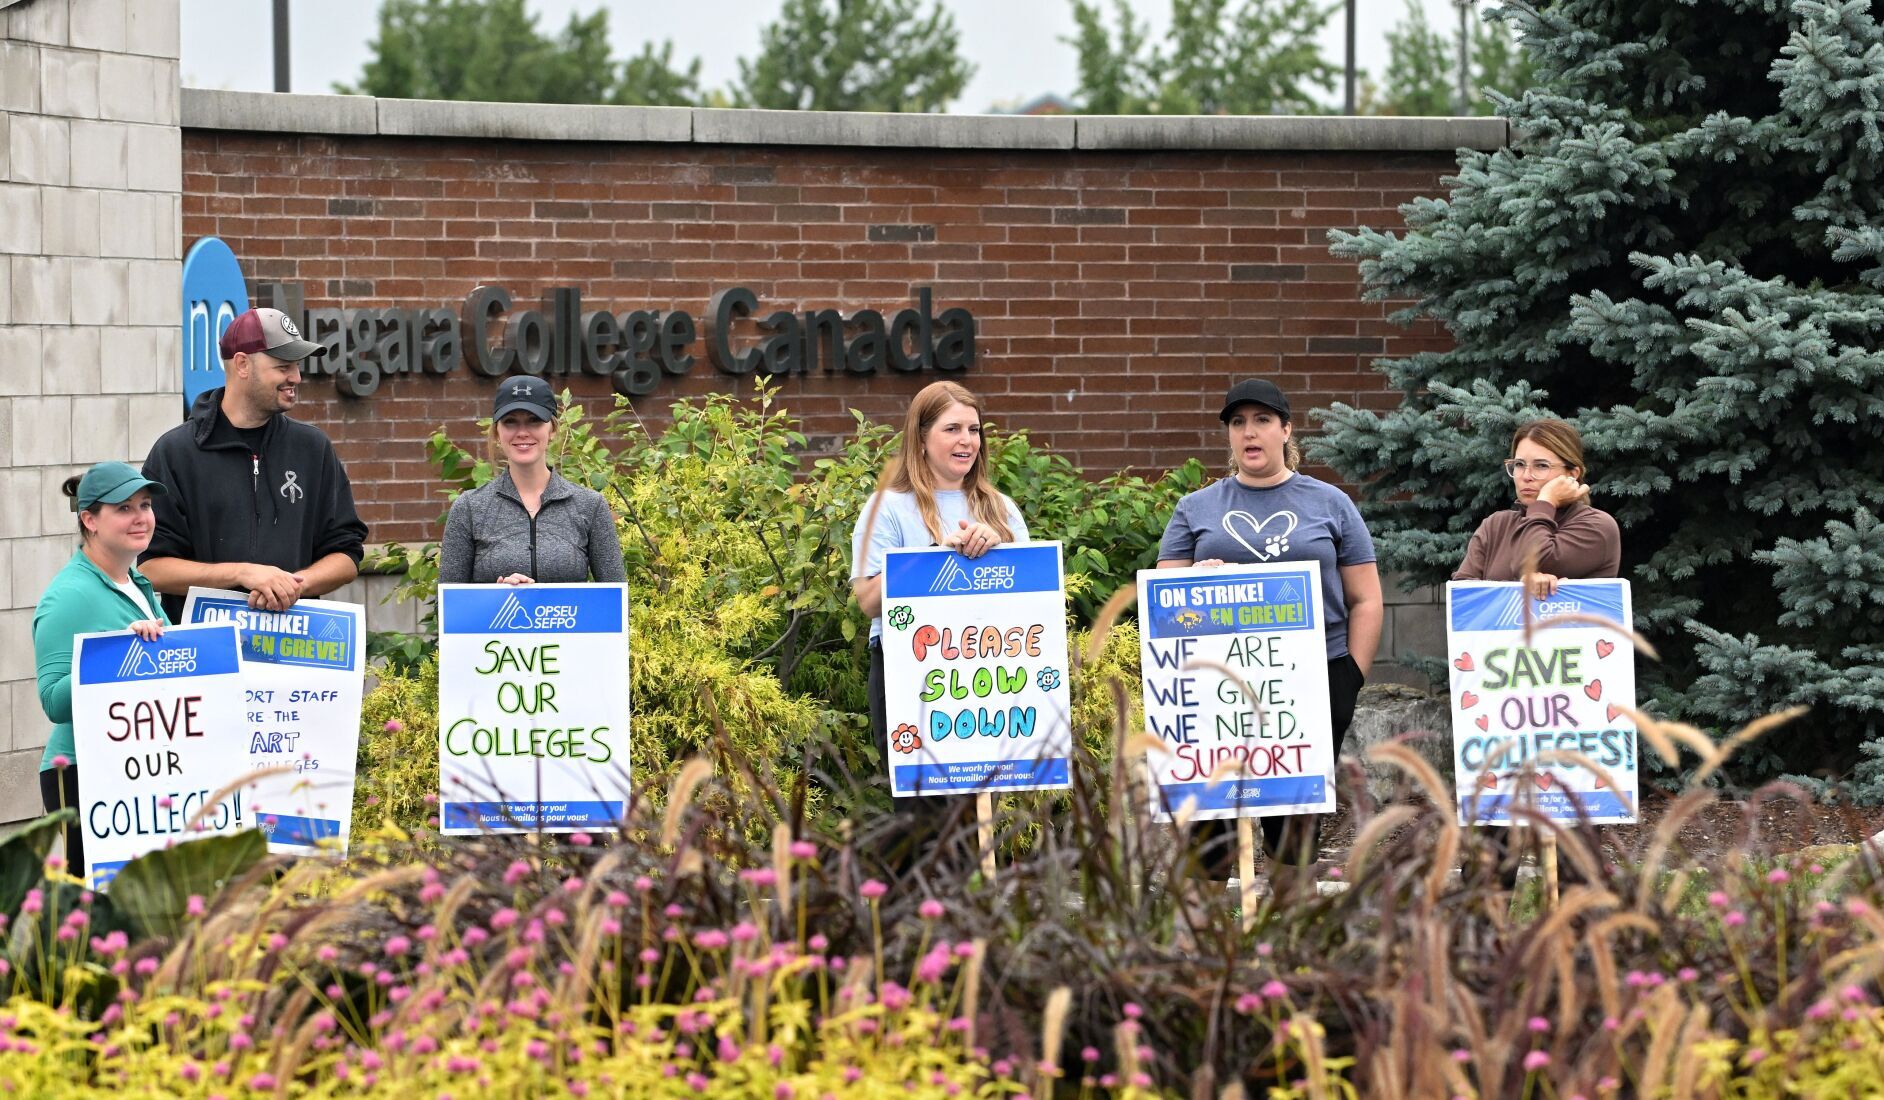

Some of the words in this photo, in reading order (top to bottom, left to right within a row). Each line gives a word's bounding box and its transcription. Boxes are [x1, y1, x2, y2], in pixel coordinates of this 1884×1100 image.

[461, 285, 697, 396] College
[704, 285, 977, 376] Canada
[973, 565, 1016, 579] OPSEU
[973, 578, 1015, 591] SEFPO
[1159, 586, 1187, 608] ON
[1190, 581, 1264, 606] STRIKE!
[1538, 601, 1581, 614] OPSEU
[203, 607, 231, 623] ON
[235, 610, 310, 636] STRIKE!
[533, 617, 577, 630] SEFPO
[534, 605, 578, 618] OPSEU
[1210, 607, 1234, 627] EN
[1238, 600, 1304, 625] GRÈVE!
[157, 647, 198, 662] OPSEU
[251, 634, 276, 656] EN
[279, 635, 346, 663] GRÈVE!
[475, 640, 561, 675] SAVE
[912, 624, 1045, 663] PLEASE
[1147, 638, 1198, 670] WE
[1225, 635, 1297, 671] ARE,
[158, 659, 198, 674] SEFPO
[1482, 646, 1585, 690] SAVE
[289, 690, 339, 703] STAFF
[497, 681, 559, 715] OUR
[919, 665, 1028, 703] SLOW
[1147, 677, 1200, 707] WE
[1216, 678, 1296, 707] GIVE,
[106, 695, 205, 742] SAVE
[274, 710, 301, 723] THE
[930, 706, 1037, 742] DOWN
[1500, 692, 1581, 731] OUR
[446, 718, 613, 763] COLLEGES
[1150, 713, 1200, 744] WE
[1216, 711, 1305, 741] NEED,
[124, 750, 183, 781] OUR
[948, 765, 961, 773] We
[962, 763, 983, 773] work
[983, 763, 996, 774] for
[1171, 743, 1312, 782] SUPPORT
[928, 775, 948, 784] Nous
[949, 773, 992, 783] travaillon
[993, 773, 1012, 783] pour
[1013, 771, 1035, 780] vous!
[501, 813, 545, 822] tvaillos
[546, 815, 565, 824] pour
[566, 813, 589, 822] vous!
[514, 803, 535, 812] work
[549, 803, 567, 814] you!
